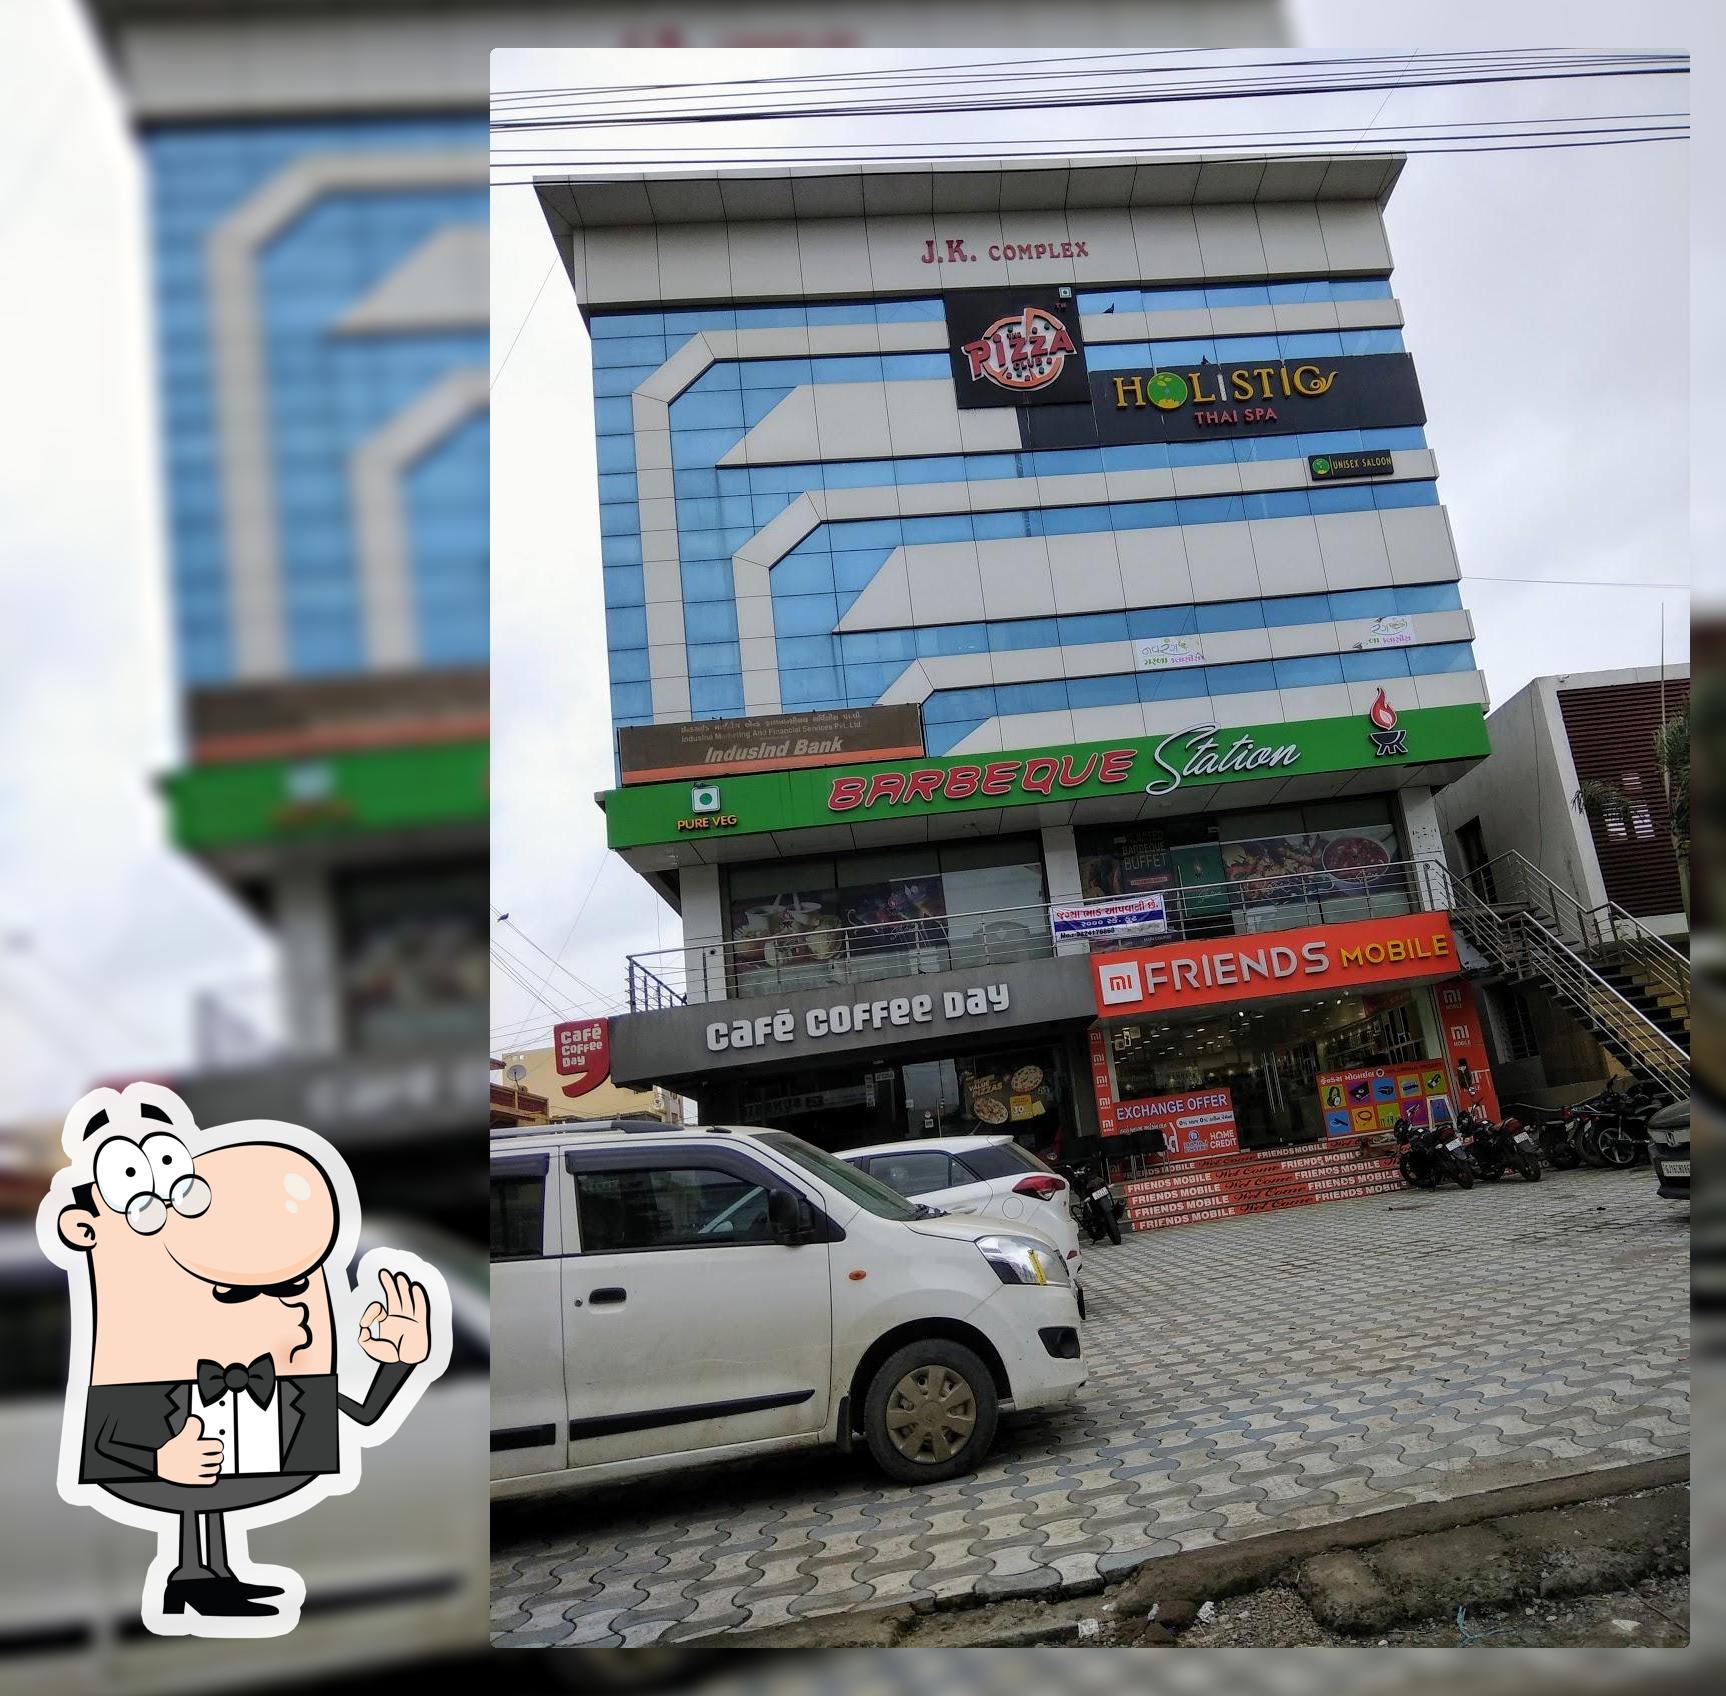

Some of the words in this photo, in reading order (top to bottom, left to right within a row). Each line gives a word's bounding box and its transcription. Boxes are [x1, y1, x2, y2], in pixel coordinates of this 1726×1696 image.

[921, 239, 977, 263] J.K.
[988, 241, 1089, 262] COMPLEX
[1113, 364, 1339, 410] HOLISTIC
[1195, 409, 1238, 426] THAI
[1245, 407, 1278, 423] SPA
[1332, 459, 1359, 470] UNISEX
[1362, 456, 1392, 468] SALOON
[794, 735, 843, 755] Bank
[828, 748, 1137, 811] BARBEQUE
[1146, 722, 1302, 796] Station
[677, 816, 709, 831] PURE
[713, 814, 737, 828] VEG
[1124, 852, 1166, 871] BUFFET
[1145, 941, 1330, 994] FRIENDS
[1341, 934, 1448, 968] MOBILE
[806, 994, 932, 1037] Coffee
[945, 983, 1010, 1018] Day
[561, 1041, 603, 1056] Coffee
[562, 1056, 585, 1067] Day
[1117, 1099, 1185, 1120] EXCHANGE
[1188, 1094, 1228, 1111] OFFER
[1210, 1130, 1234, 1141] HOME
[1210, 1138, 1237, 1149] CREDIT
[1128, 1178, 1171, 1193] FRIENDS
[1174, 1172, 1212, 1186] MOBILE
[1281, 1156, 1322, 1169] FRIENDS
[1132, 1189, 1178, 1205] FRIENDS
[1181, 1183, 1221, 1197] MOBILE
[1295, 1165, 1339, 1180] FRIENDS
[1341, 1159, 1380, 1174] MOBILE
[1135, 1202, 1184, 1218] FRIENDS
[1186, 1195, 1229, 1209] MOBILE
[1308, 1176, 1355, 1191] FRIENDS
[1358, 1169, 1400, 1183] MOBILE
[1140, 1214, 1189, 1230] FRIENDS
[1192, 1207, 1235, 1221] MOBILE
[1315, 1187, 1364, 1201] FRIENDS
